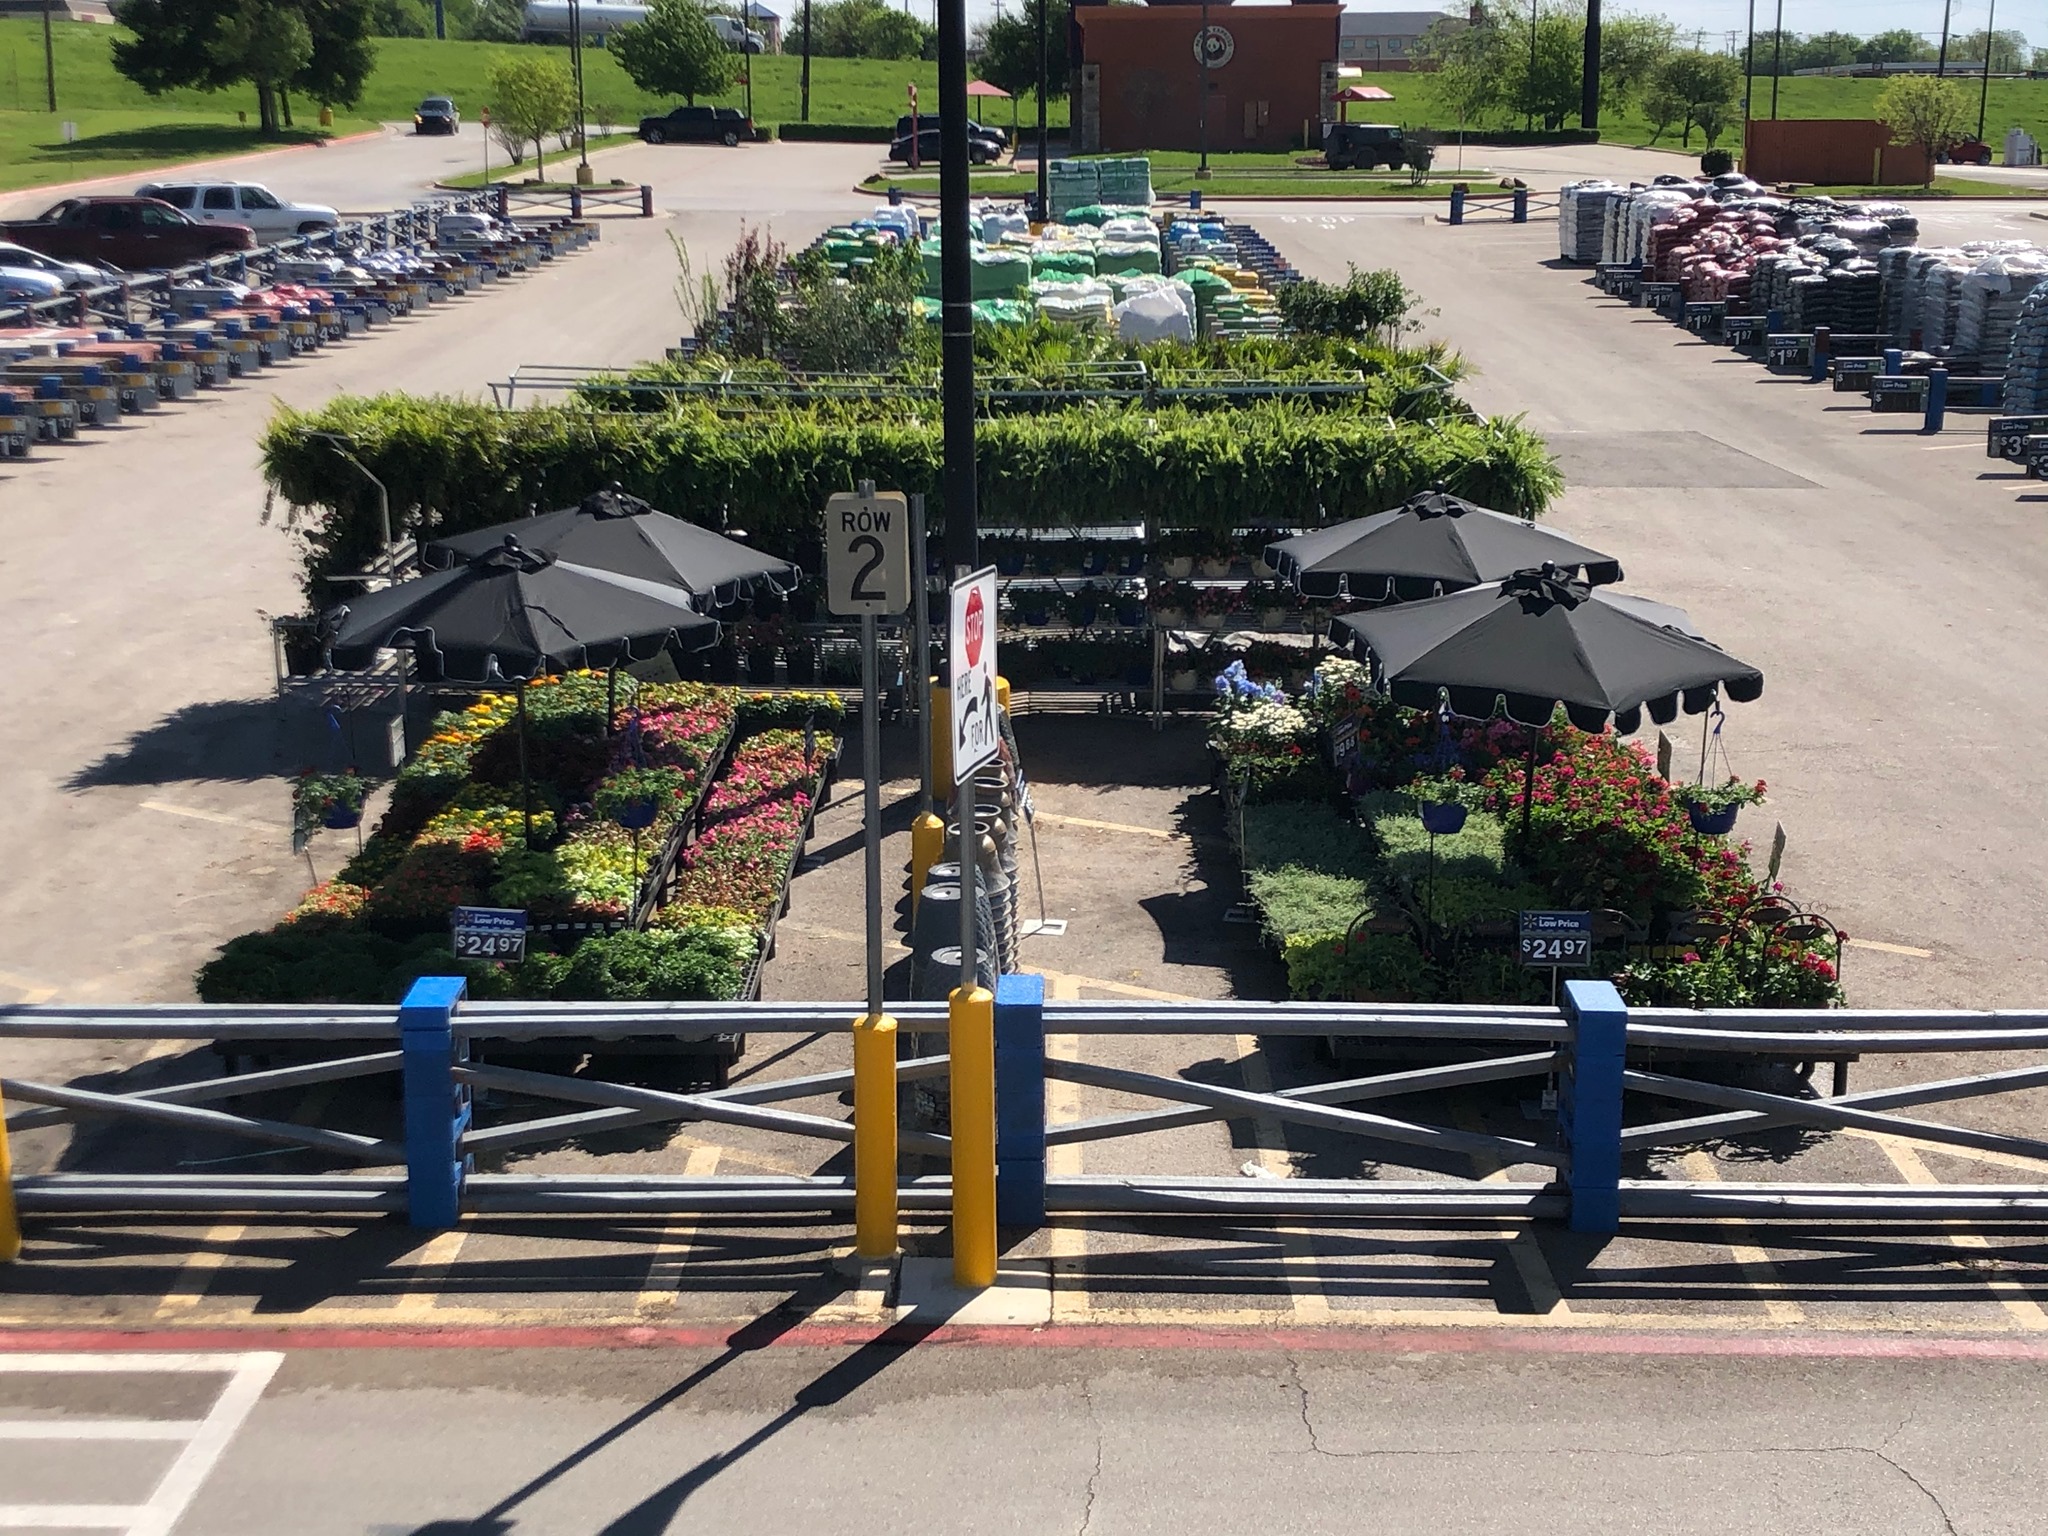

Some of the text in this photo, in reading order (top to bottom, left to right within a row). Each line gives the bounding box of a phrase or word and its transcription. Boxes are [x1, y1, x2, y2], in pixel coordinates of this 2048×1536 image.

[1726, 330, 1752, 345] $197
[1770, 349, 1798, 366] $197
[2000, 436, 2030, 456] $36
[841, 512, 891, 532] ROW
[848, 534, 886, 600] 2
[966, 610, 983, 645] STOP
[956, 670, 972, 701] HERE
[972, 720, 984, 748] FOR
[458, 936, 522, 956] $2497
[1522, 939, 1586, 959] $2497
